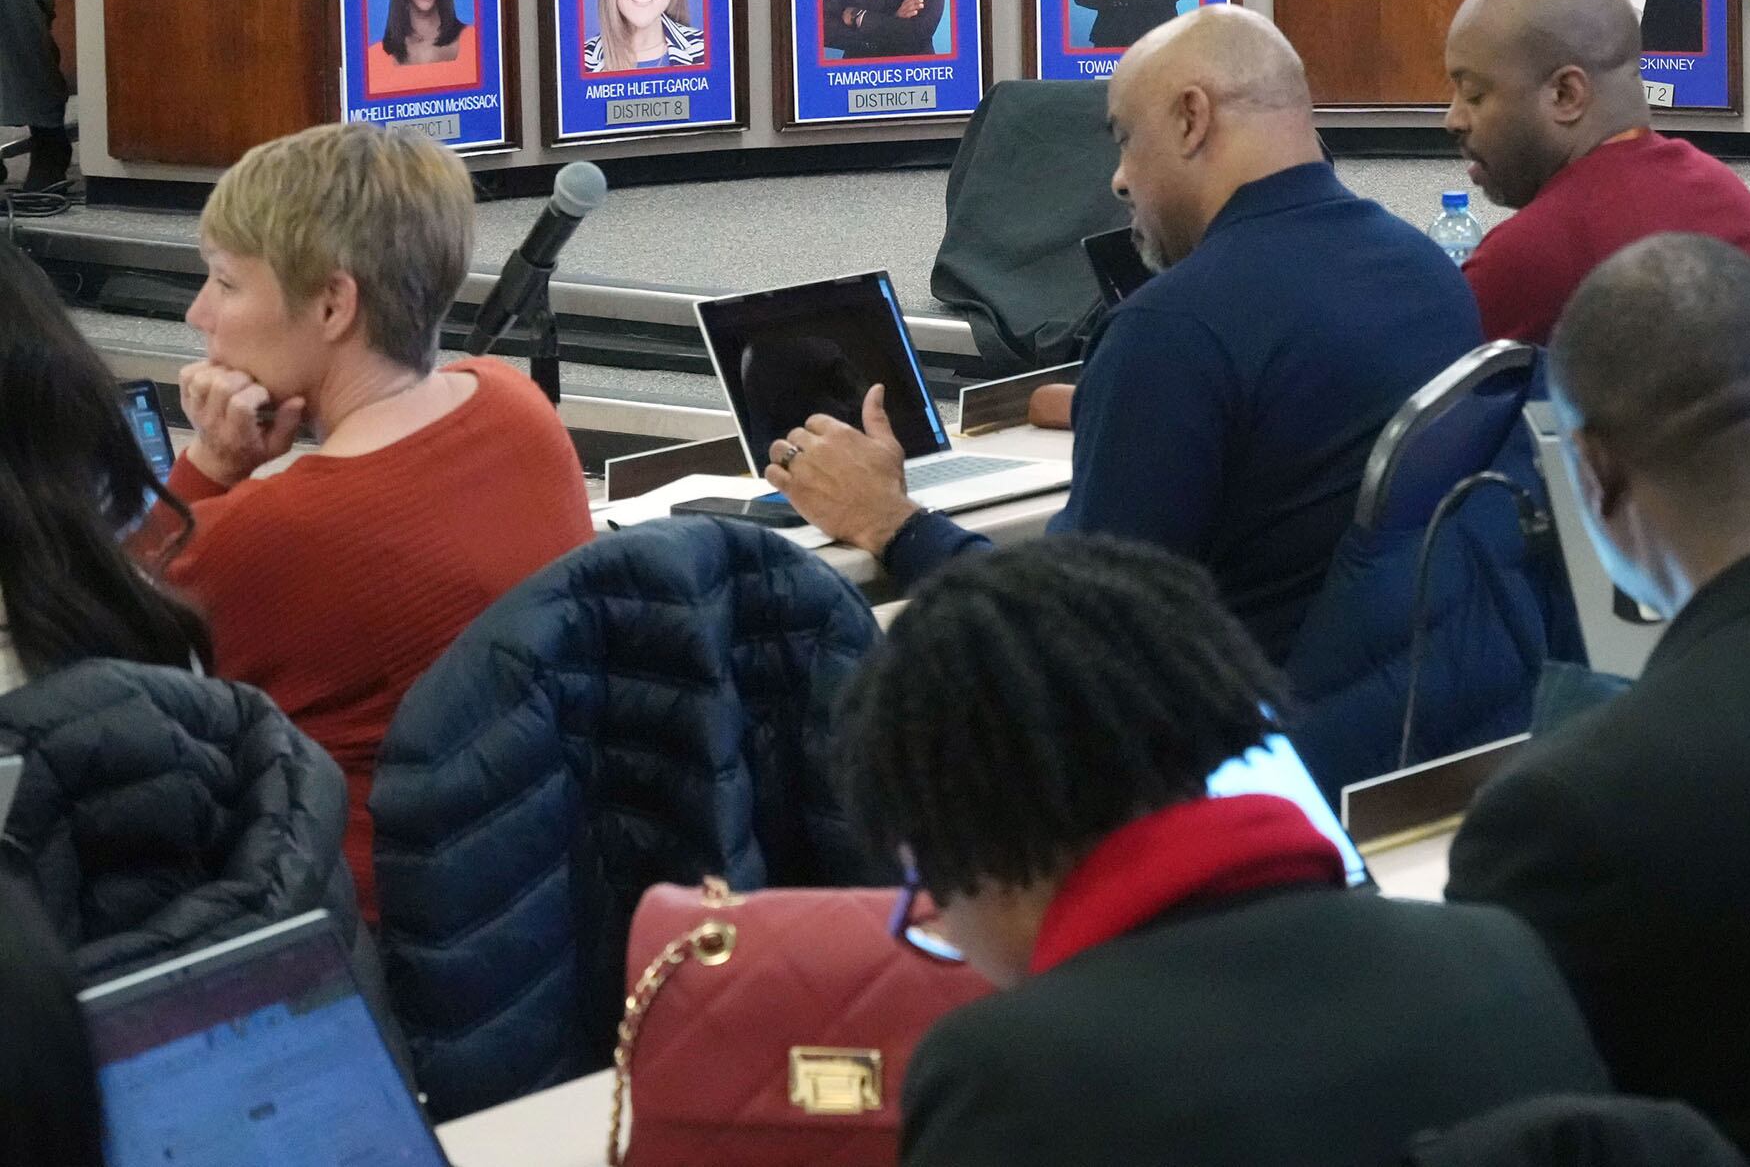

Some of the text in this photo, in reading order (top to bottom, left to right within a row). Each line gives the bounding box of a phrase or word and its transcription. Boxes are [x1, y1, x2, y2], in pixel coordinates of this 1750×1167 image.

[1639, 57, 1696, 71] CKINNEY
[827, 66, 954, 86] TAMARQUES PORTER
[585, 77, 709, 100] AMBER HUETT-GARCIA
[1657, 87, 1667, 102] 2
[350, 94, 499, 123] MICHELLE ROBINSON McKISSACK
[855, 90, 930, 109] DISTRICT 4
[612, 100, 684, 120] DISTRICT 8
[447, 119, 454, 135] 1
